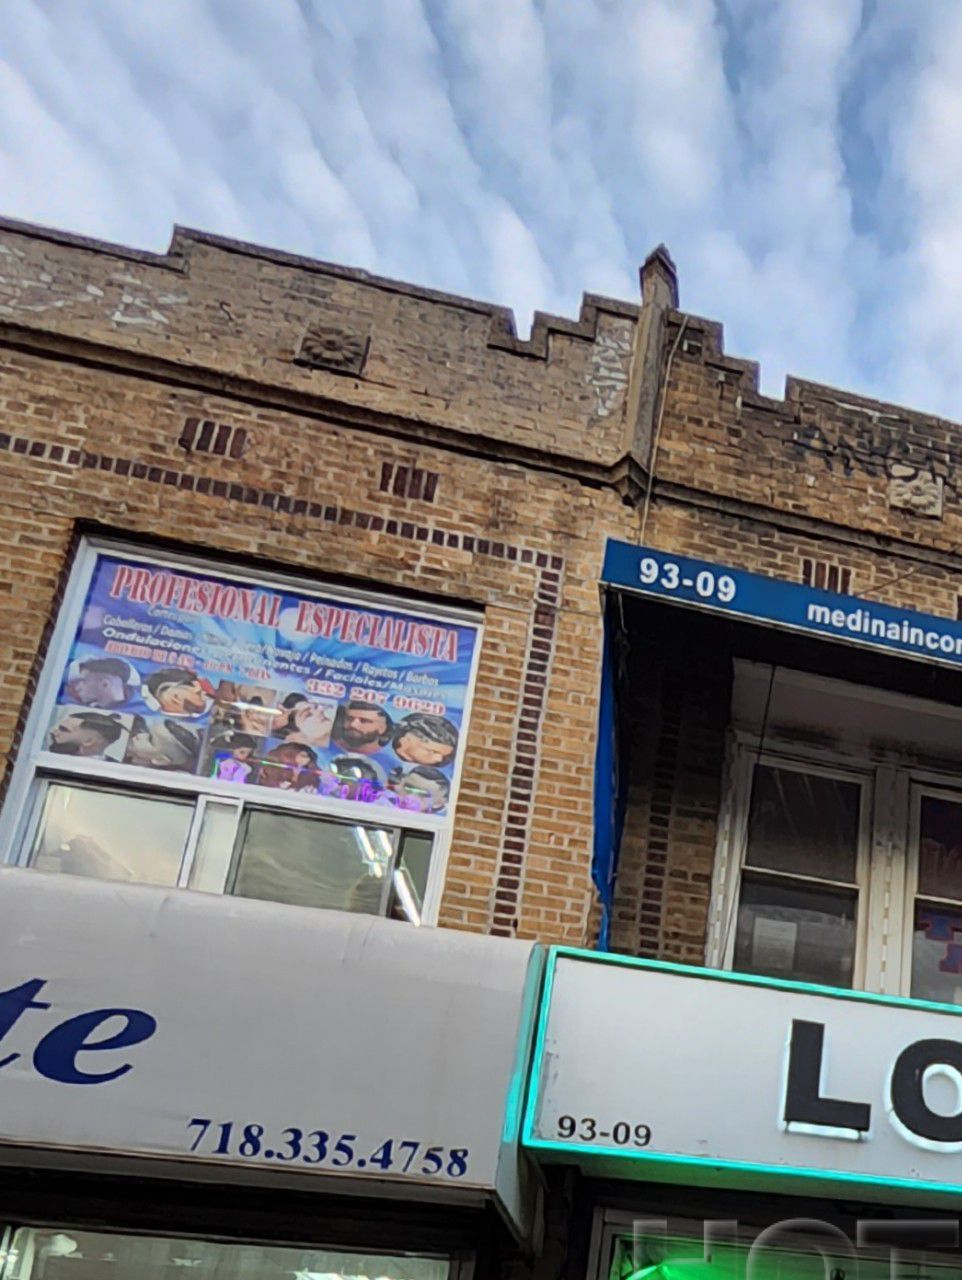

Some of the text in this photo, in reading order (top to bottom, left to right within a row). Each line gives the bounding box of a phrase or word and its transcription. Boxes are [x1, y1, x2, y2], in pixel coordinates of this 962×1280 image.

[639, 557, 737, 603] 93-09
[110, 564, 282, 630] PROFESIONAL
[295, 600, 458, 663] ESPECIALISTA
[187, 1117, 470, 1180] 718.335.4758
[556, 1114, 653, 1148] 93-09
